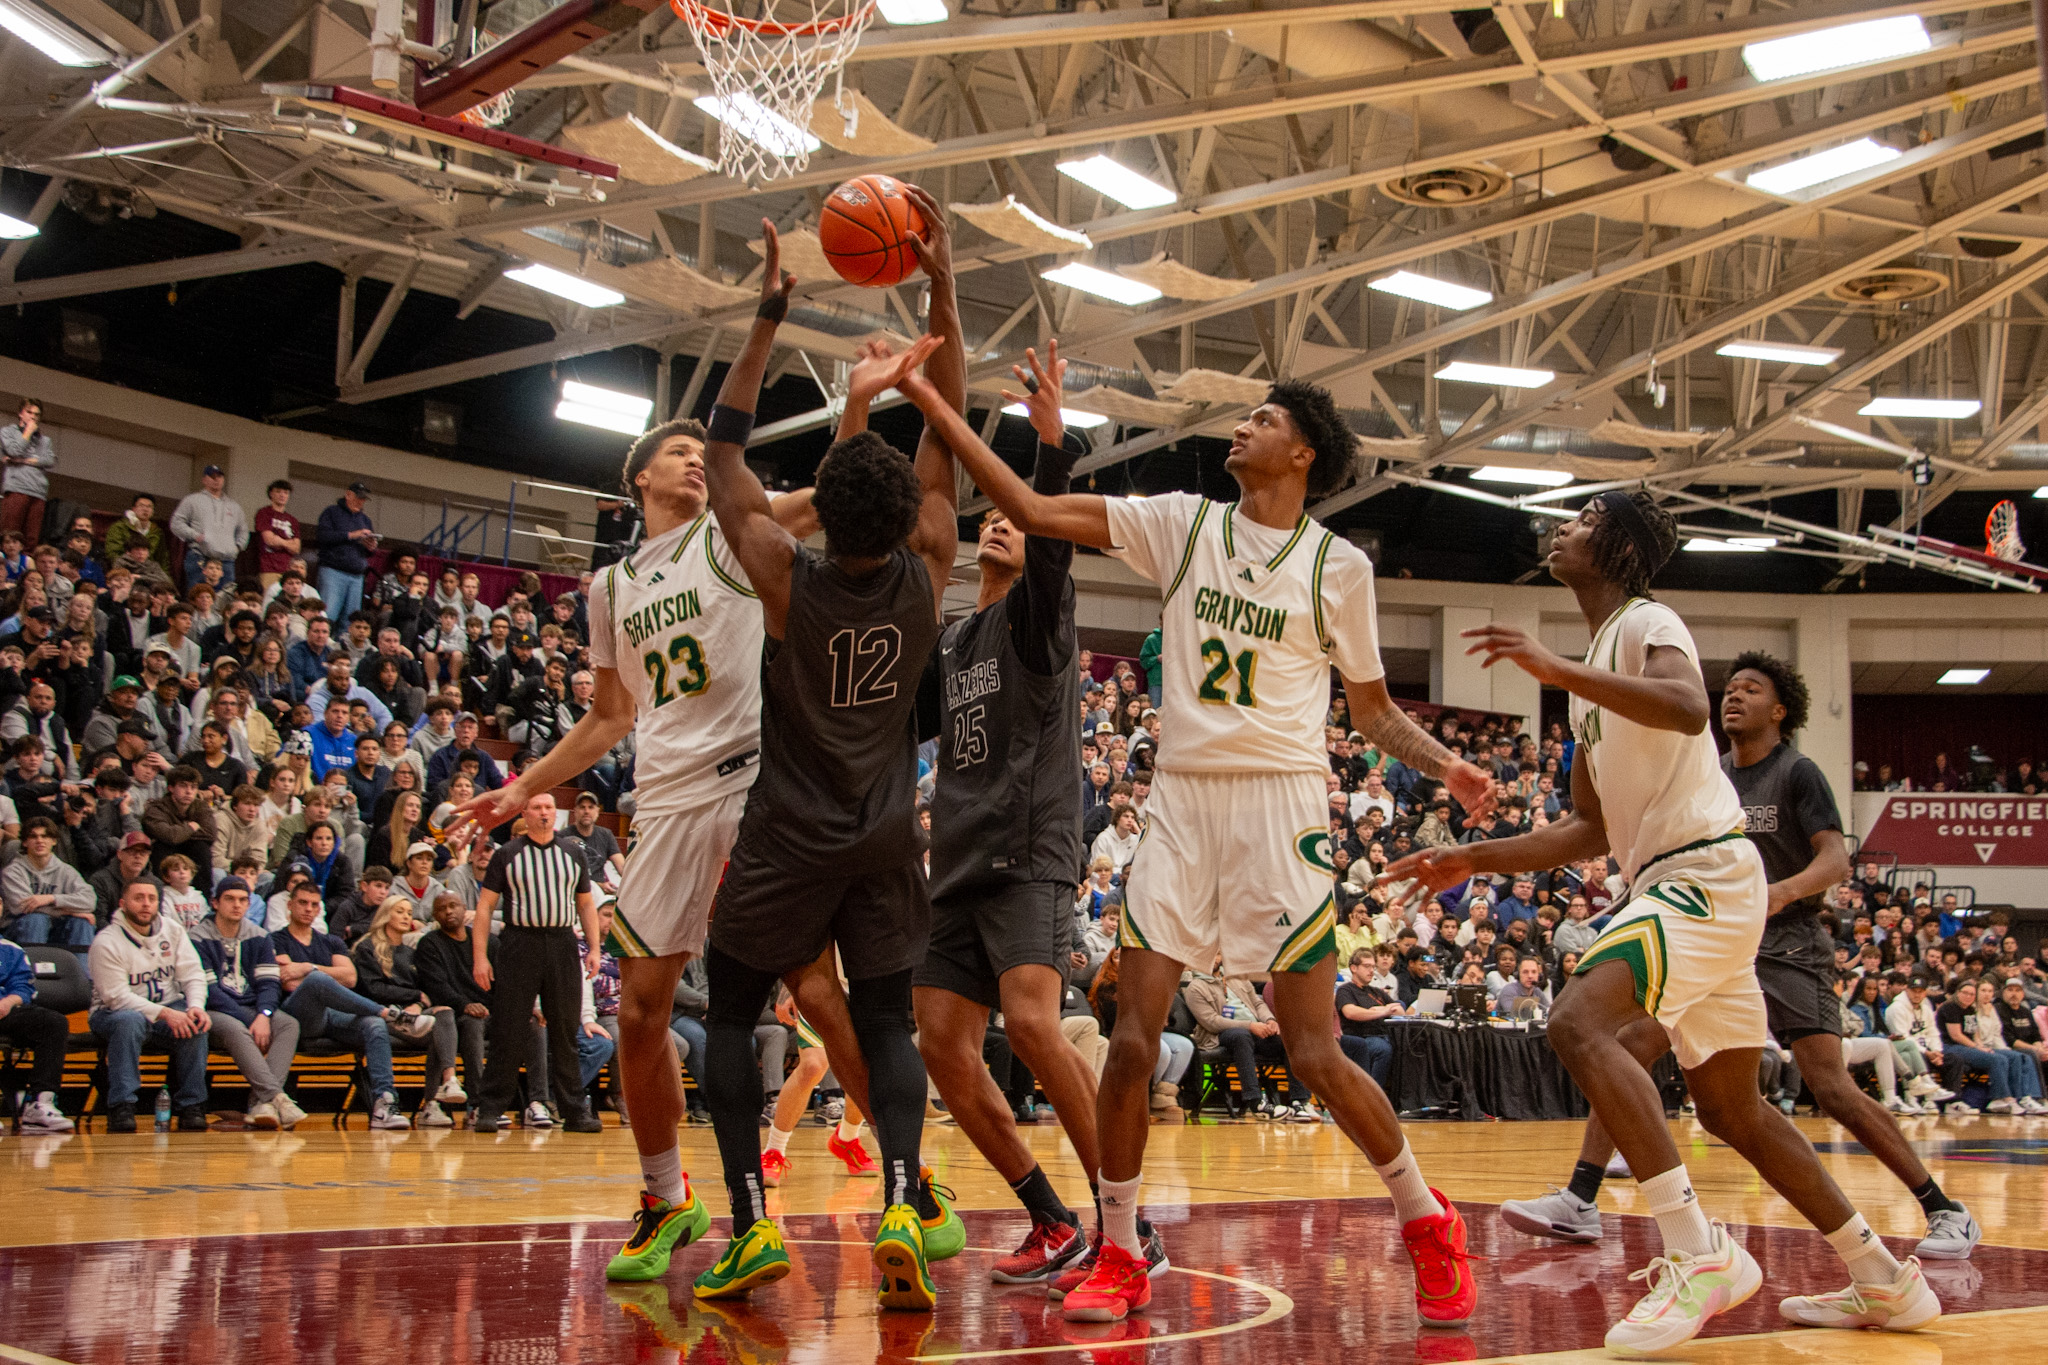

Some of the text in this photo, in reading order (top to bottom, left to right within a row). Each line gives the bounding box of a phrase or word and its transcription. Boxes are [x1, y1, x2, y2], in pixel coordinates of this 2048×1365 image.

[623, 587, 702, 648] GRAYSON
[1195, 586, 1288, 643] GRAYSON
[644, 632, 712, 710] 23
[828, 623, 902, 708] 12
[1199, 635, 1259, 709] 21
[953, 704, 989, 771] 25
[1741, 805, 1778, 832] ERS
[1891, 801, 2048, 820] SPRINGFIE
[1937, 825, 2033, 837] COLLEGE
